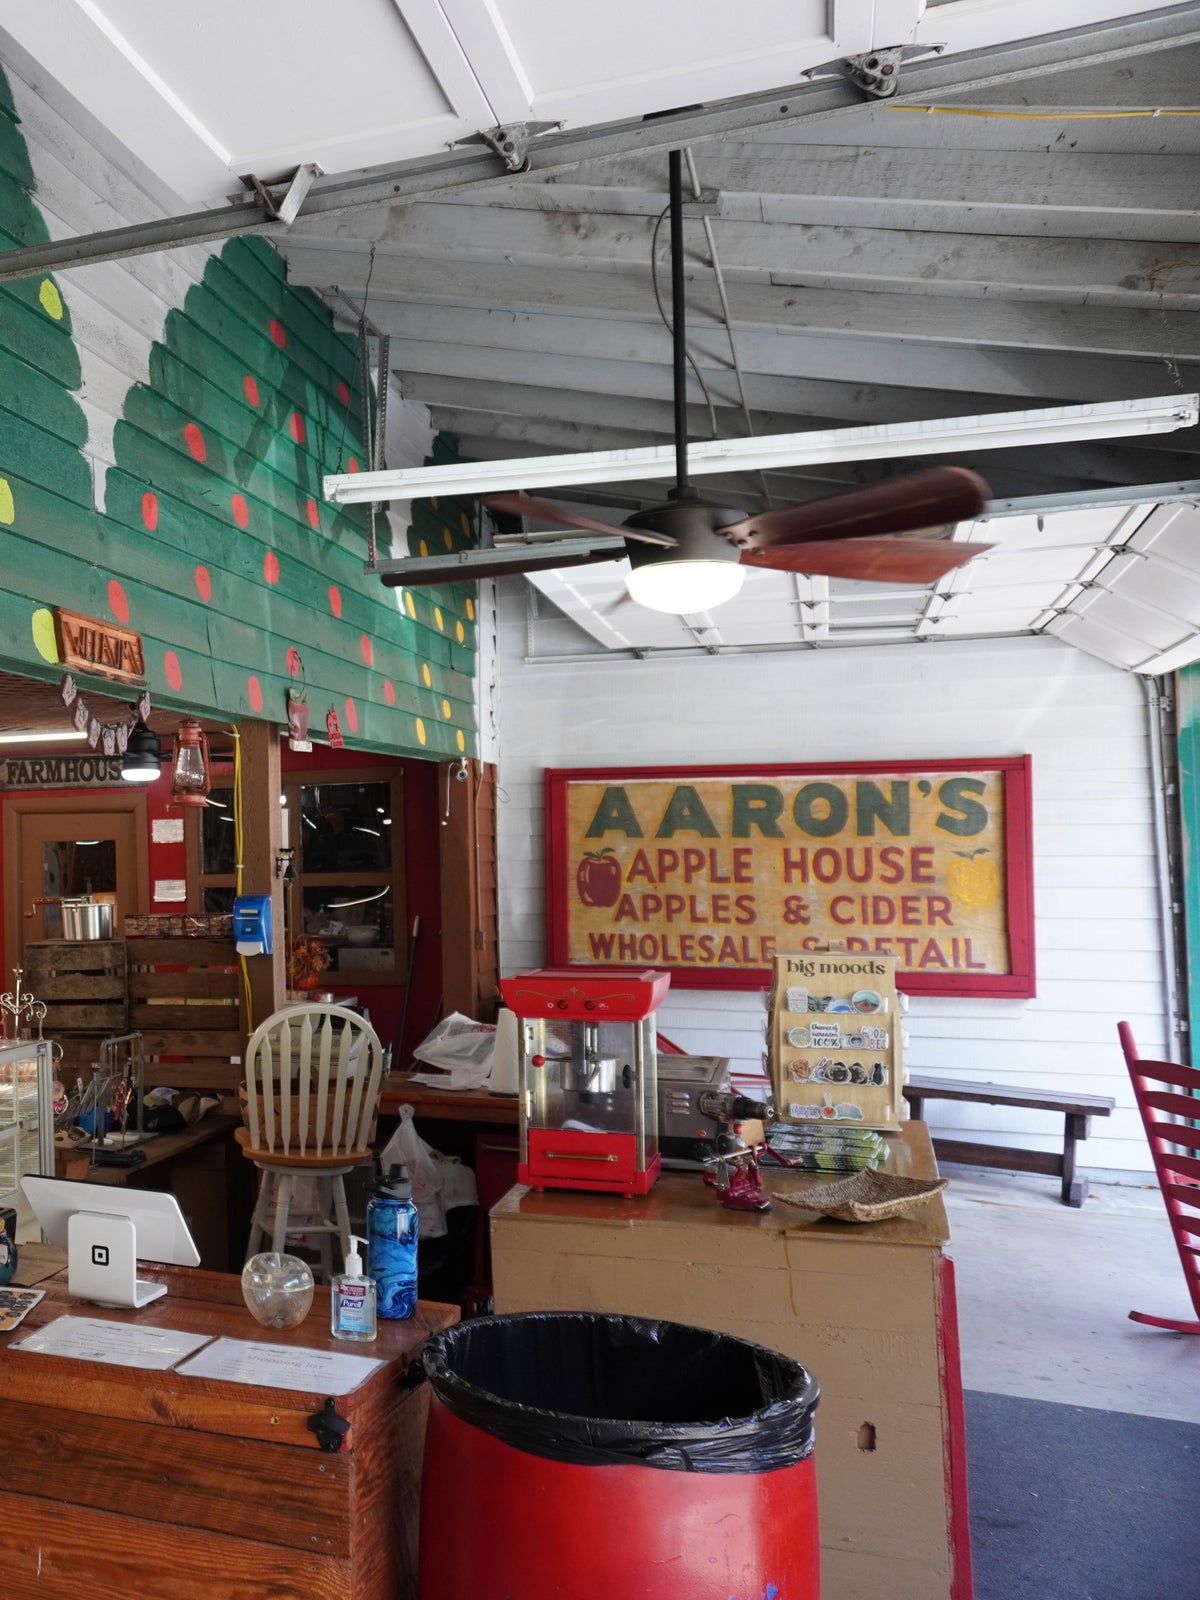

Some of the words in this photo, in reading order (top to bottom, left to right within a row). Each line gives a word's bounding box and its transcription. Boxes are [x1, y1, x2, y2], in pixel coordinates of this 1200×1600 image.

[6, 759, 125, 785] FARMHOUS
[584, 777, 989, 839] AARON'S
[626, 847, 755, 884] APPLE
[783, 846, 935, 884] HOUSE
[613, 893, 758, 926] APPLES
[783, 894, 811, 925] &
[829, 895, 954, 926] CIDER
[588, 932, 777, 964] WHOLESALE
[787, 960, 815, 977] big
[820, 961, 886, 975] moods
[813, 1038, 839, 1047] 100%
[343, 1299, 362, 1308] Purell
